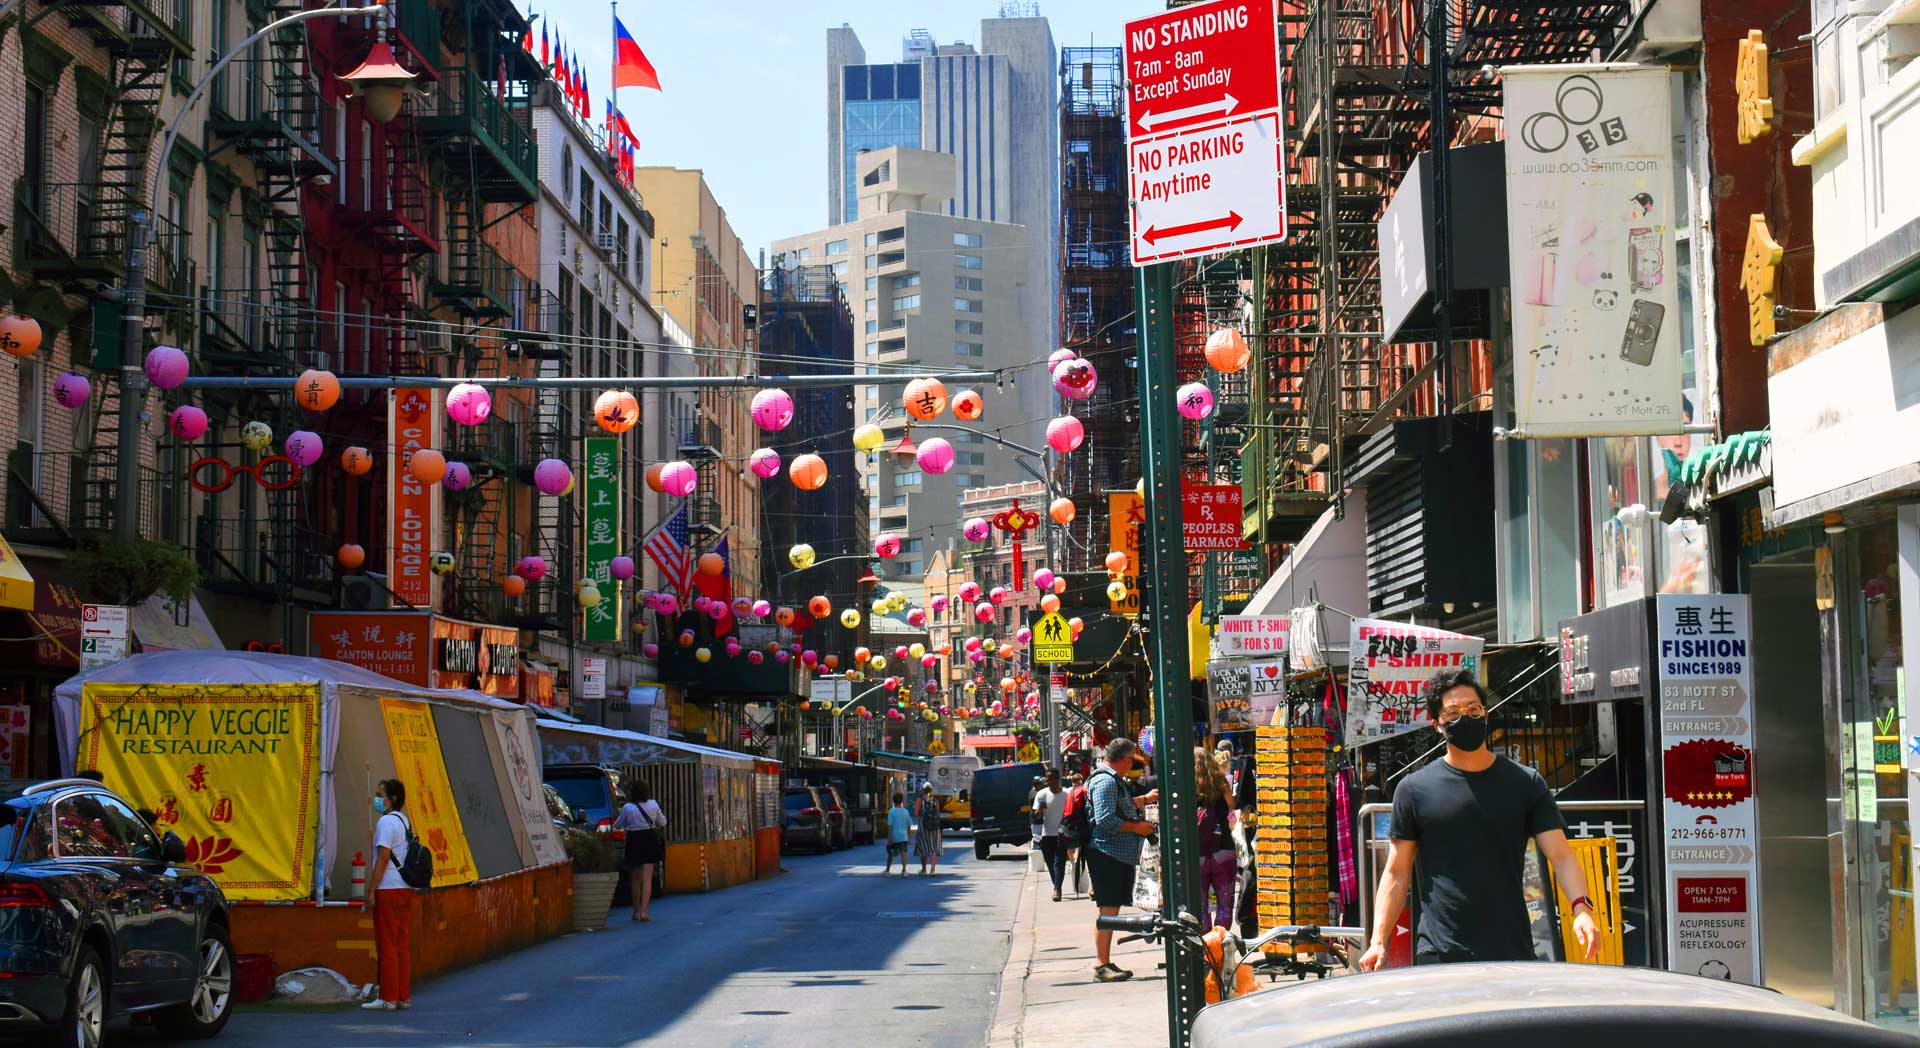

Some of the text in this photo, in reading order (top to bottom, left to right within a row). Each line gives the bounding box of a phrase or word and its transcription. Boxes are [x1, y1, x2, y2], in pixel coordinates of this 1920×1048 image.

[1132, 6, 1248, 53] NO STANDING
[1134, 59, 1162, 79] 7am
[1175, 50, 1204, 69] 8am
[1135, 67, 1232, 102] Except Sunday
[1138, 132, 1244, 174] NO PARKING
[1522, 157, 1658, 174] www.oo35mm.com
[1141, 172, 1211, 202] Anytime
[56, 384, 70, 401] 吉
[917, 391, 936, 416] 吉
[1184, 392, 1204, 410] 和
[1182, 492, 1241, 505] 安西藥房
[1183, 523, 1234, 535] PEOPLES
[402, 508, 422, 576] LOUNGE
[882, 540, 892, 554] 吉
[1184, 537, 1241, 548] HARMACY
[1224, 620, 1253, 632] WHITE
[1675, 606, 1736, 636] 惠生
[1244, 637, 1262, 650] FOR
[1272, 637, 1282, 650] 10
[1662, 640, 1746, 658] FISHION
[336, 650, 414, 660] CANTON LOUNGE
[1038, 650, 1070, 658] SCHOOL
[1214, 669, 1232, 678] UCK
[1256, 666, 1264, 679] I
[1668, 662, 1742, 675] SINCE1989
[1254, 680, 1280, 692] NY
[1664, 686, 1736, 697] 83 MOTT ST
[1665, 700, 1704, 711] 2nd FL
[115, 708, 290, 736] HAPPY VEGGIE
[1666, 721, 1721, 732] ENTRANCE
[122, 738, 281, 754] RESTAURANT
[1672, 828, 1746, 840] 212-966-8771
[1671, 850, 1726, 860] ENTRANCE
[1684, 886, 1738, 895] OPEN 7 DAYS
[1692, 896, 1730, 904] 11AM-7PM
[1680, 920, 1745, 928] ACUPRESSURE
[1680, 930, 1719, 938] SHIATSU
[1680, 940, 1746, 949] REFLEXOLOGY
